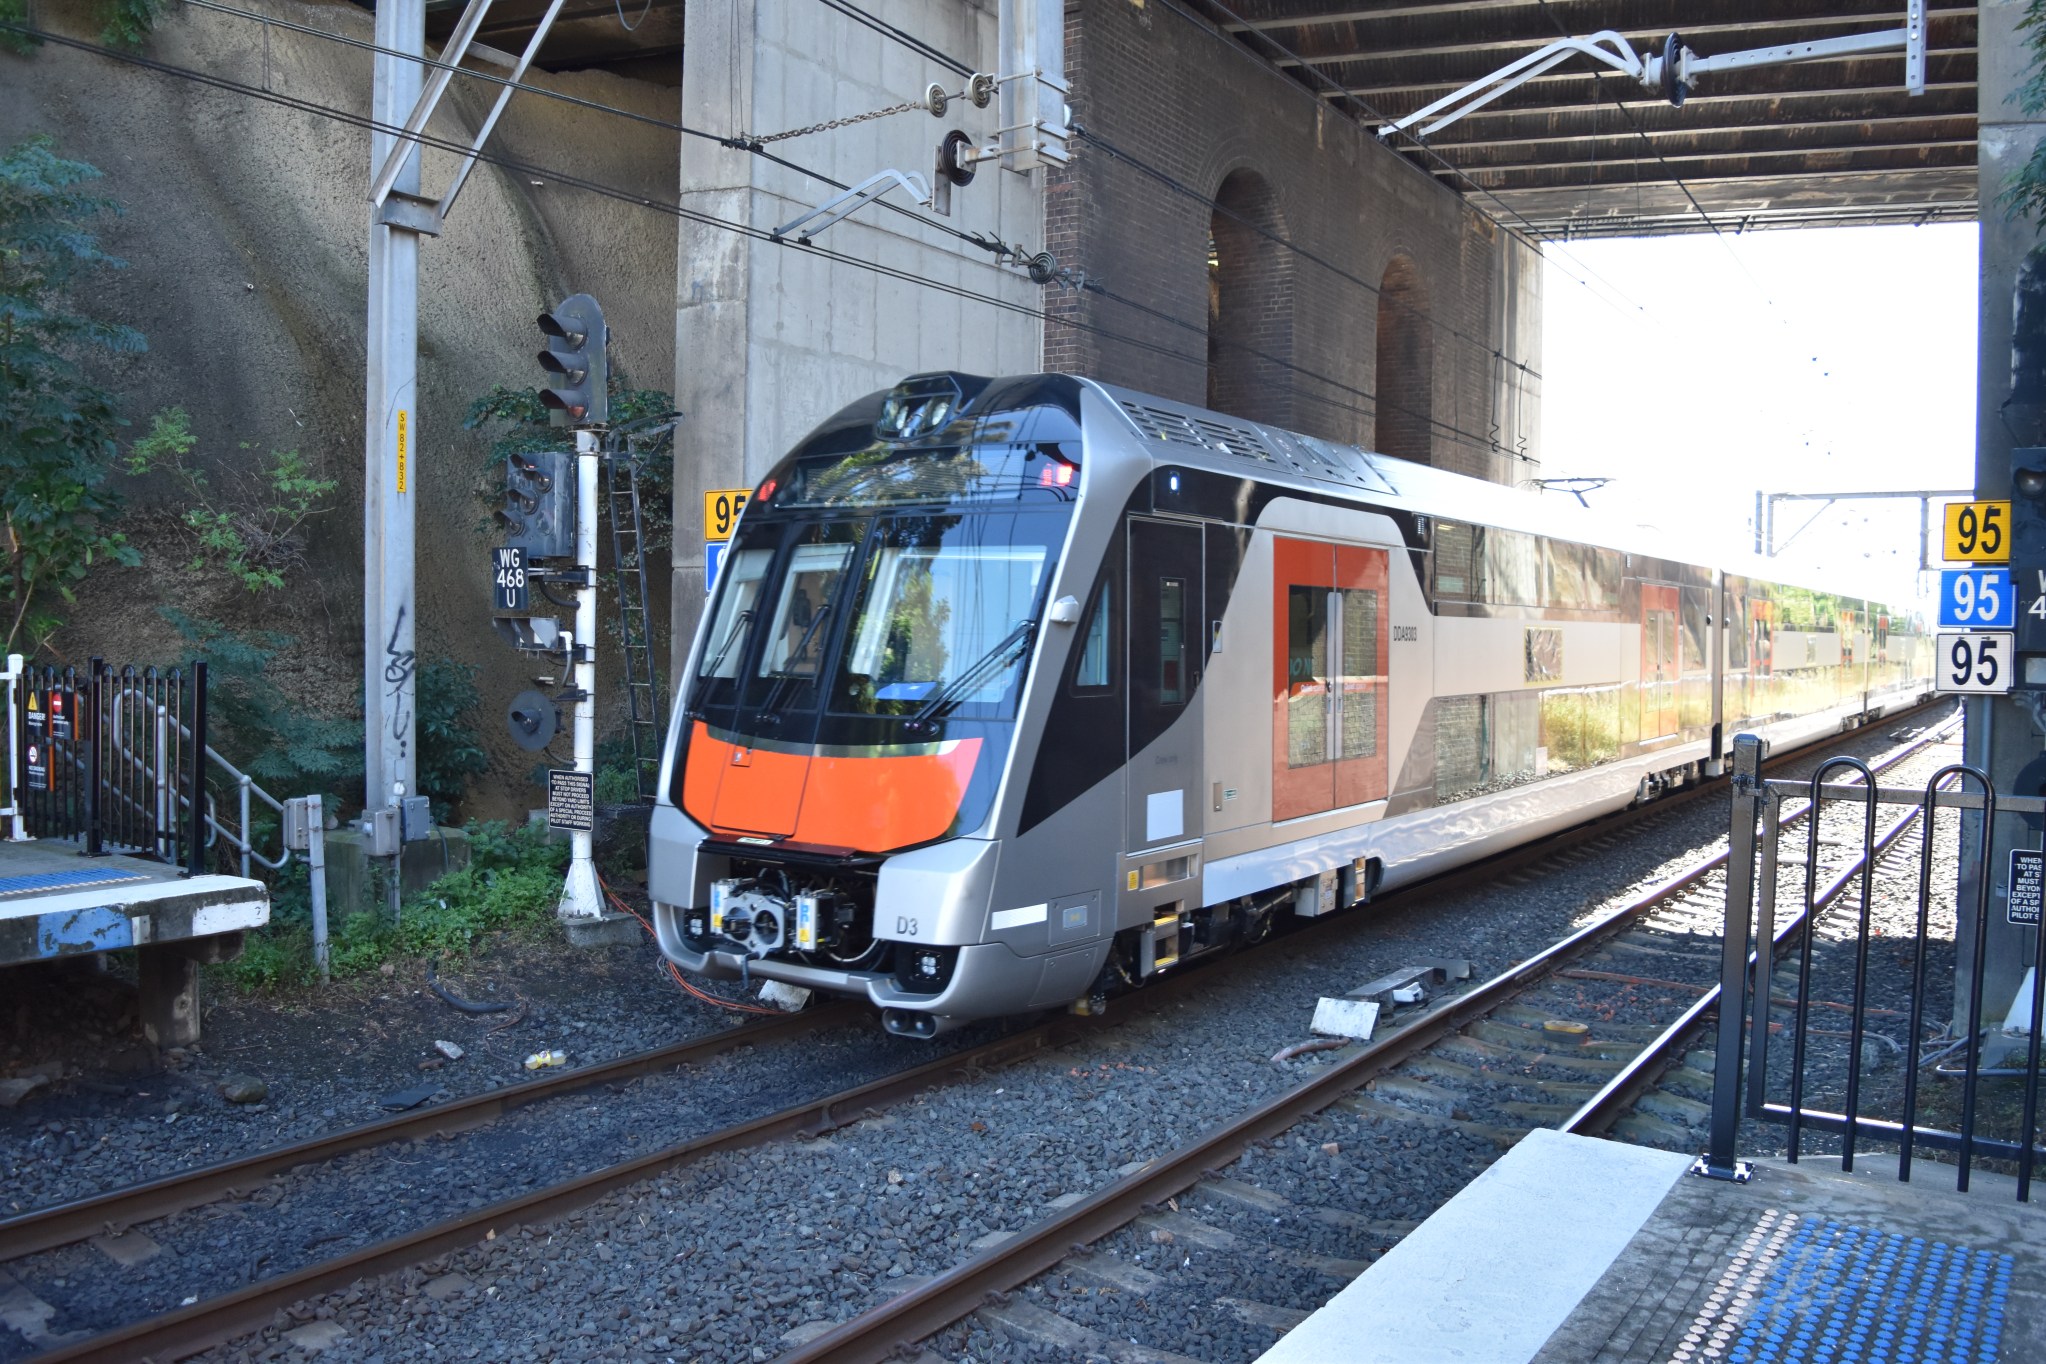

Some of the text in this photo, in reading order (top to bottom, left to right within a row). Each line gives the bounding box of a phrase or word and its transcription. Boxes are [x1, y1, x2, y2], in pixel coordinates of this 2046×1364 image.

[1958, 508, 2001, 554] 95
[500, 549, 519, 567] WG
[497, 569, 524, 587] 468
[506, 589, 515, 607] U
[1954, 574, 1999, 621] 95
[1952, 639, 1998, 686] 95
[897, 916, 918, 936] D3
